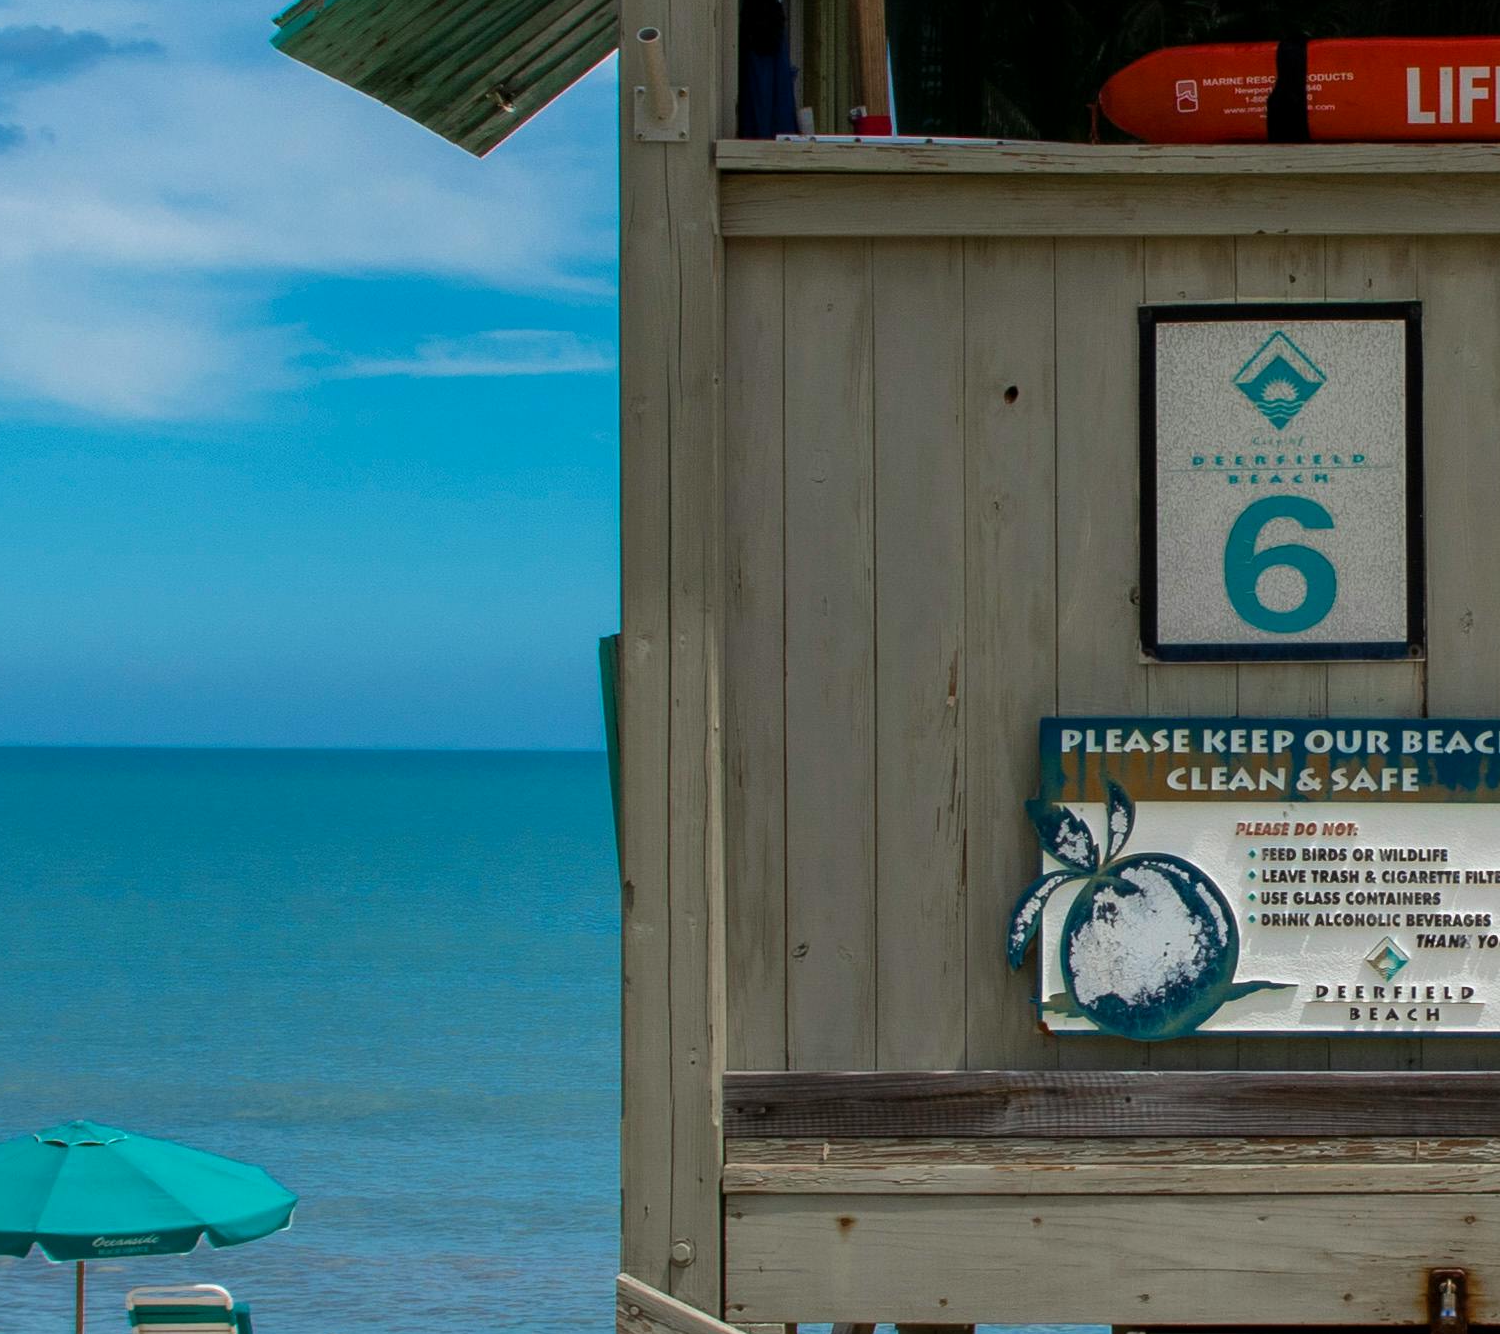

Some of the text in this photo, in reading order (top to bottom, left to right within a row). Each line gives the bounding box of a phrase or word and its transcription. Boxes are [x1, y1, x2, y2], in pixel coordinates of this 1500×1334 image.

[1202, 71, 1355, 87] MARINE RESC ODUCTS
[1191, 453, 1366, 467] DEERFIELD
[1227, 473, 1329, 485] BEACH
[1223, 494, 1338, 635] 6
[1060, 728, 1191, 754] PLEASE
[1202, 729, 1296, 754] KEEP
[1303, 728, 1391, 755] OUR
[1165, 767, 1420, 793] CLEAN & SAFE
[1235, 821, 1359, 837] PLEASE DO NOT:
[1261, 847, 1449, 862] FEED BIRDS OR WILDLIFE
[1262, 870, 1307, 885] LEAVE
[1311, 870, 1360, 885] TRASH
[1364, 870, 1377, 885] &
[1381, 870, 1461, 885] CIGARETTE
[1260, 892, 1441, 906] USE GLASS CONTAINERS
[1261, 913, 1492, 928] DRINK ALCOHOLIC BEVERAGES
[1416, 934, 1472, 949] THANK
[1315, 984, 1475, 1000] DEERFIELD
[1349, 1007, 1441, 1022] BEACH
